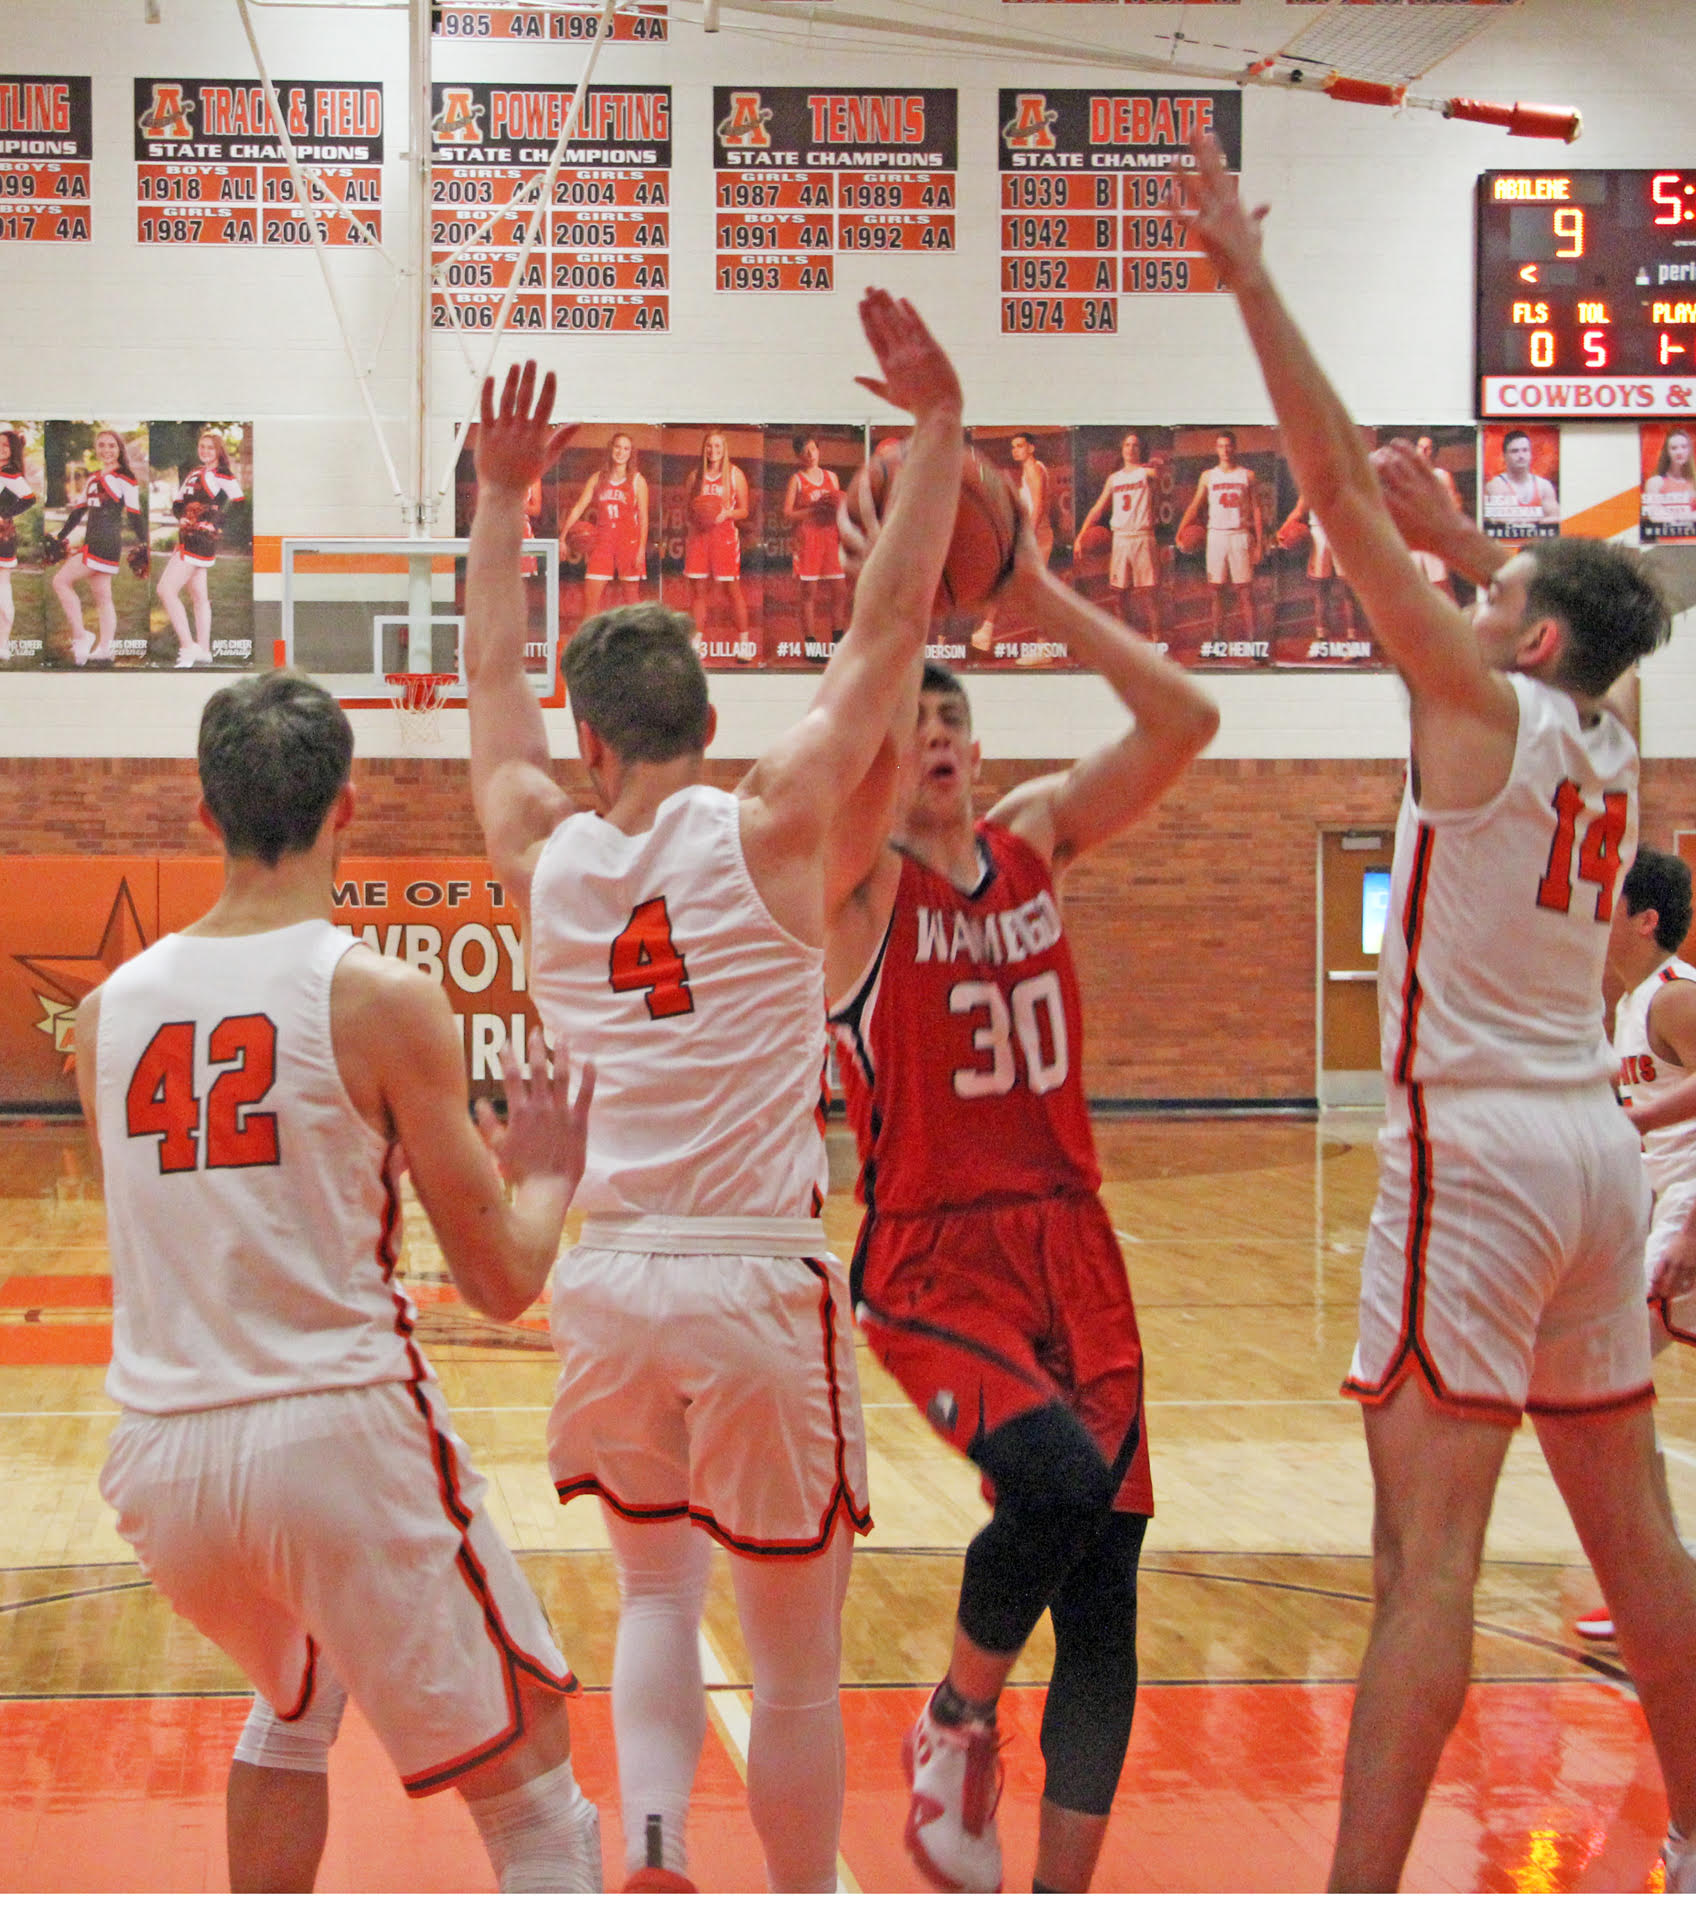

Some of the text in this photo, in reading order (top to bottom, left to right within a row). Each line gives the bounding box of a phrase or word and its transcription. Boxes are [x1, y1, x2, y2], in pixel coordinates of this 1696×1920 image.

[438, 15, 541, 36] 985 4A
[633, 17, 664, 39] 4A
[200, 87, 381, 137] TRACK & FIELD
[490, 91, 668, 140] POWERLIFTING
[807, 95, 925, 143] TENNIS
[1089, 97, 1213, 145] DEBATE
[149, 144, 369, 160] STATE CHAMPIONS
[439, 148, 656, 163] STATE CHAMPIONS
[727, 152, 943, 166] STATE CHAMPIONS
[1012, 153, 1083, 167] STATE
[0, 163, 61, 172] BOYS
[166, 166, 228, 175] BOYS
[303, 168, 353, 177] OYS
[454, 169, 521, 178] GIRLS
[577, 170, 644, 180] GIRLS
[741, 173, 808, 182] GIRLS
[864, 173, 930, 183] GIRLS
[0, 175, 87, 198] 99 4A
[140, 178, 256, 200] 1918 ALL
[345, 180, 380, 201] ALL
[433, 181, 541, 203] 2003 4A
[556, 183, 665, 204] 2004 4A
[721, 185, 829, 206] 1987 4A
[843, 186, 951, 207] 1989 4A
[1009, 177, 1110, 206] 1939 B
[1494, 179, 1571, 200] ABILENE
[0, 205, 62, 214] BOYS
[163, 208, 232, 217] GIRLS
[291, 209, 352, 218] BOYS
[456, 210, 518, 219] BOYS
[576, 212, 644, 221] GIRLS
[744, 214, 805, 223] BOYS
[864, 215, 930, 224] GIRLS
[56, 217, 88, 240] 4A
[143, 220, 254, 242] 1987 4A
[267, 221, 378, 243] 2006 4A
[433, 223, 492, 244] 2004
[556, 224, 665, 246] 2005 4A
[721, 227, 829, 248] 1991 4A
[843, 227, 951, 249] 1992 4A
[1009, 219, 1110, 248] 1942 B
[1131, 219, 1189, 248] 1947
[1553, 208, 1585, 258] 9
[457, 252, 520, 261] BOYS
[576, 254, 644, 263] GIRLS
[741, 255, 808, 264] GIRLS
[433, 265, 493, 286] 005
[556, 266, 665, 288] 2006 4A
[721, 268, 830, 289] 1993 4A
[1009, 260, 1110, 289] 1952 A
[1131, 261, 1189, 290] 1959
[576, 296, 644, 305] GIRLS
[433, 306, 543, 328] 2006 4A
[556, 308, 665, 329] 2007 4A
[1006, 301, 1114, 331] 1974 3A
[1512, 302, 1549, 324] FLS
[1577, 302, 1610, 324] TOL
[1530, 330, 1555, 368] 0
[1582, 330, 1606, 368] 5
[1499, 384, 1692, 408] COWBOYS &
[228, 640, 252, 649] CHEER
[710, 642, 757, 657] LILLARD
[776, 642, 801, 657] #14
[994, 643, 1067, 658] #14 BRYSON
[1201, 642, 1269, 657] #42 HEINTZ
[1309, 642, 1327, 657] #5
[1536, 777, 1628, 923] 14
[405, 882, 471, 908] OF
[914, 890, 1063, 964] WAMEGO
[608, 895, 695, 1021] 4
[949, 970, 1069, 1099] 30
[127, 1013, 280, 1174] 42
